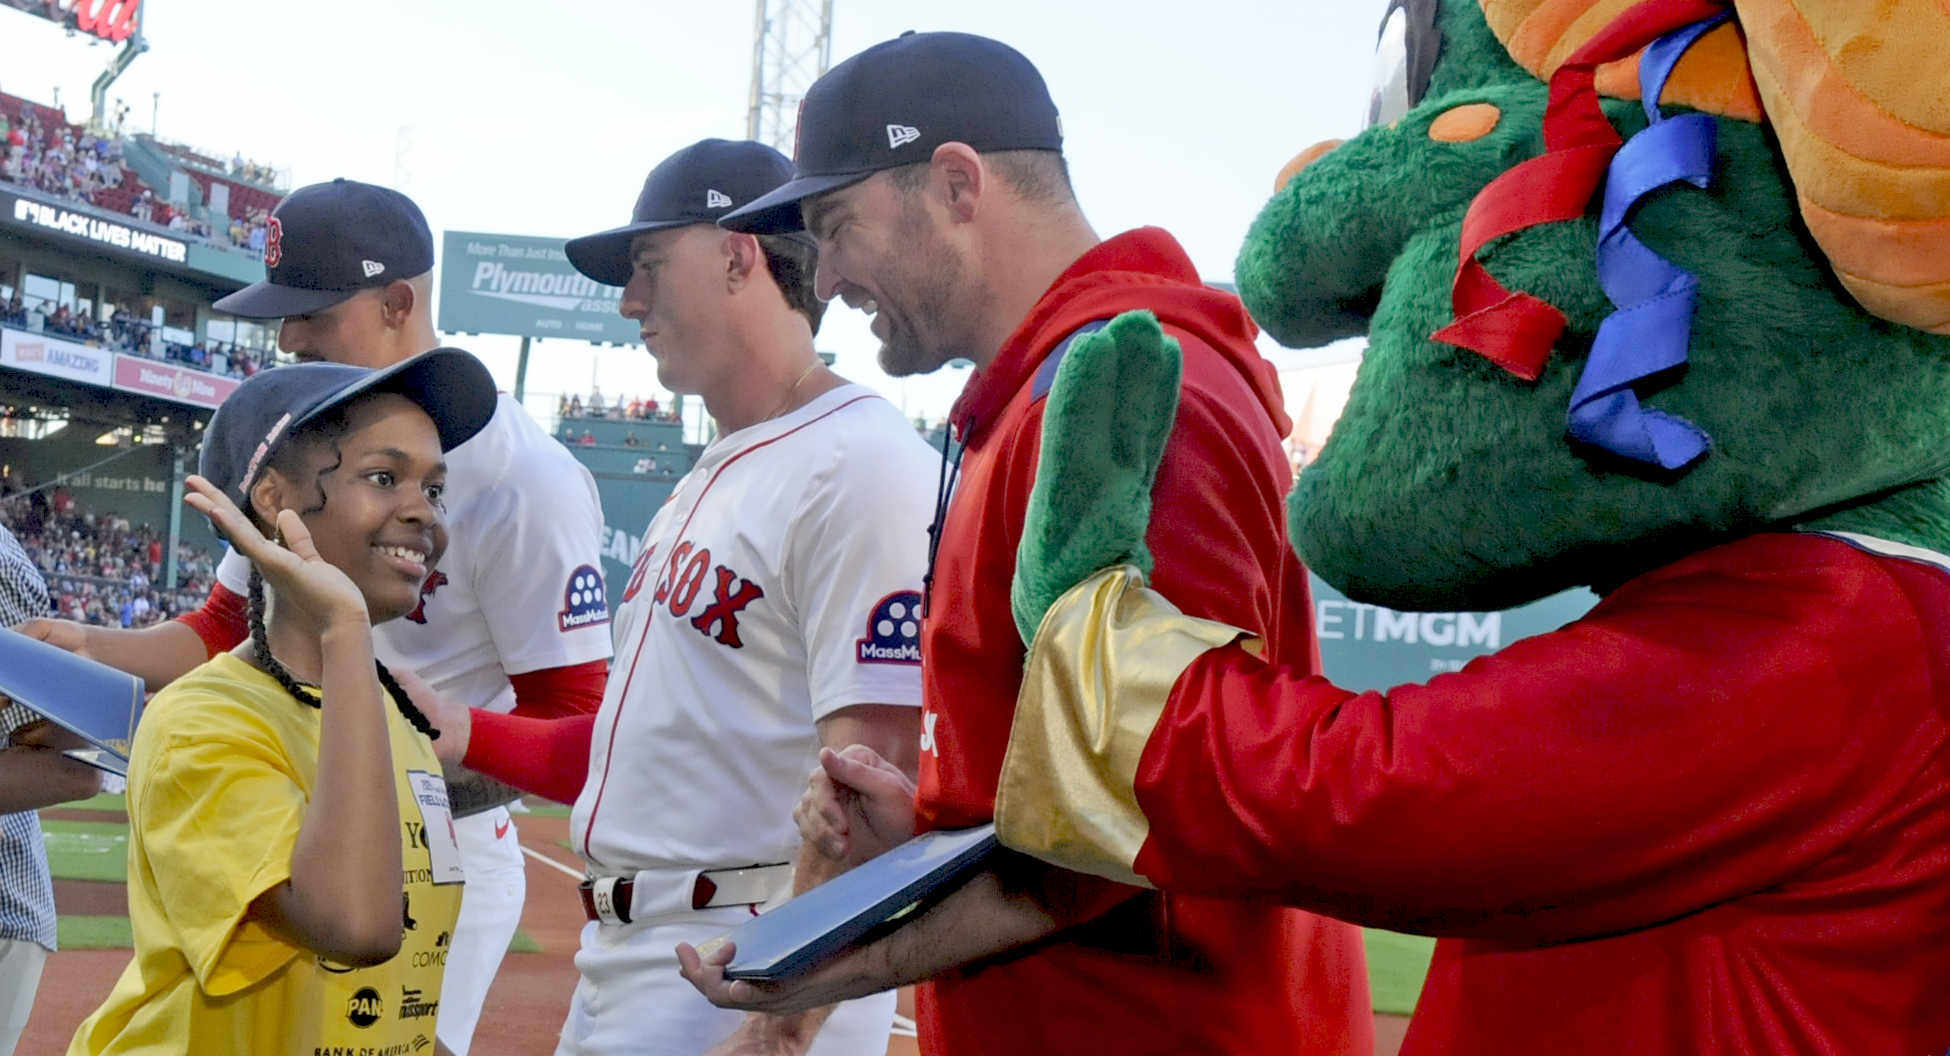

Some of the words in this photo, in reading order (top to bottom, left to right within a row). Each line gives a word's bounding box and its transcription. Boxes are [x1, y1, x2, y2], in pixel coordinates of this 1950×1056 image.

[39, 205, 90, 237] BLACK
[90, 219, 131, 248] LIVES
[131, 230, 187, 263] MATTER
[466, 242, 497, 257] More
[498, 243, 525, 259] Than
[472, 261, 598, 298] Plymouth
[46, 349, 99, 374] AMAZING
[140, 367, 174, 391] Ninety
[192, 379, 217, 398] Nine
[71, 473, 92, 488] all
[95, 476, 140, 492] starts
[653, 540, 764, 649] SOX
[597, 892, 611, 915] 23
[314, 1047, 355, 1056] BANK
[359, 1047, 375, 1056] OF
[378, 1043, 410, 1056] AMERICA
